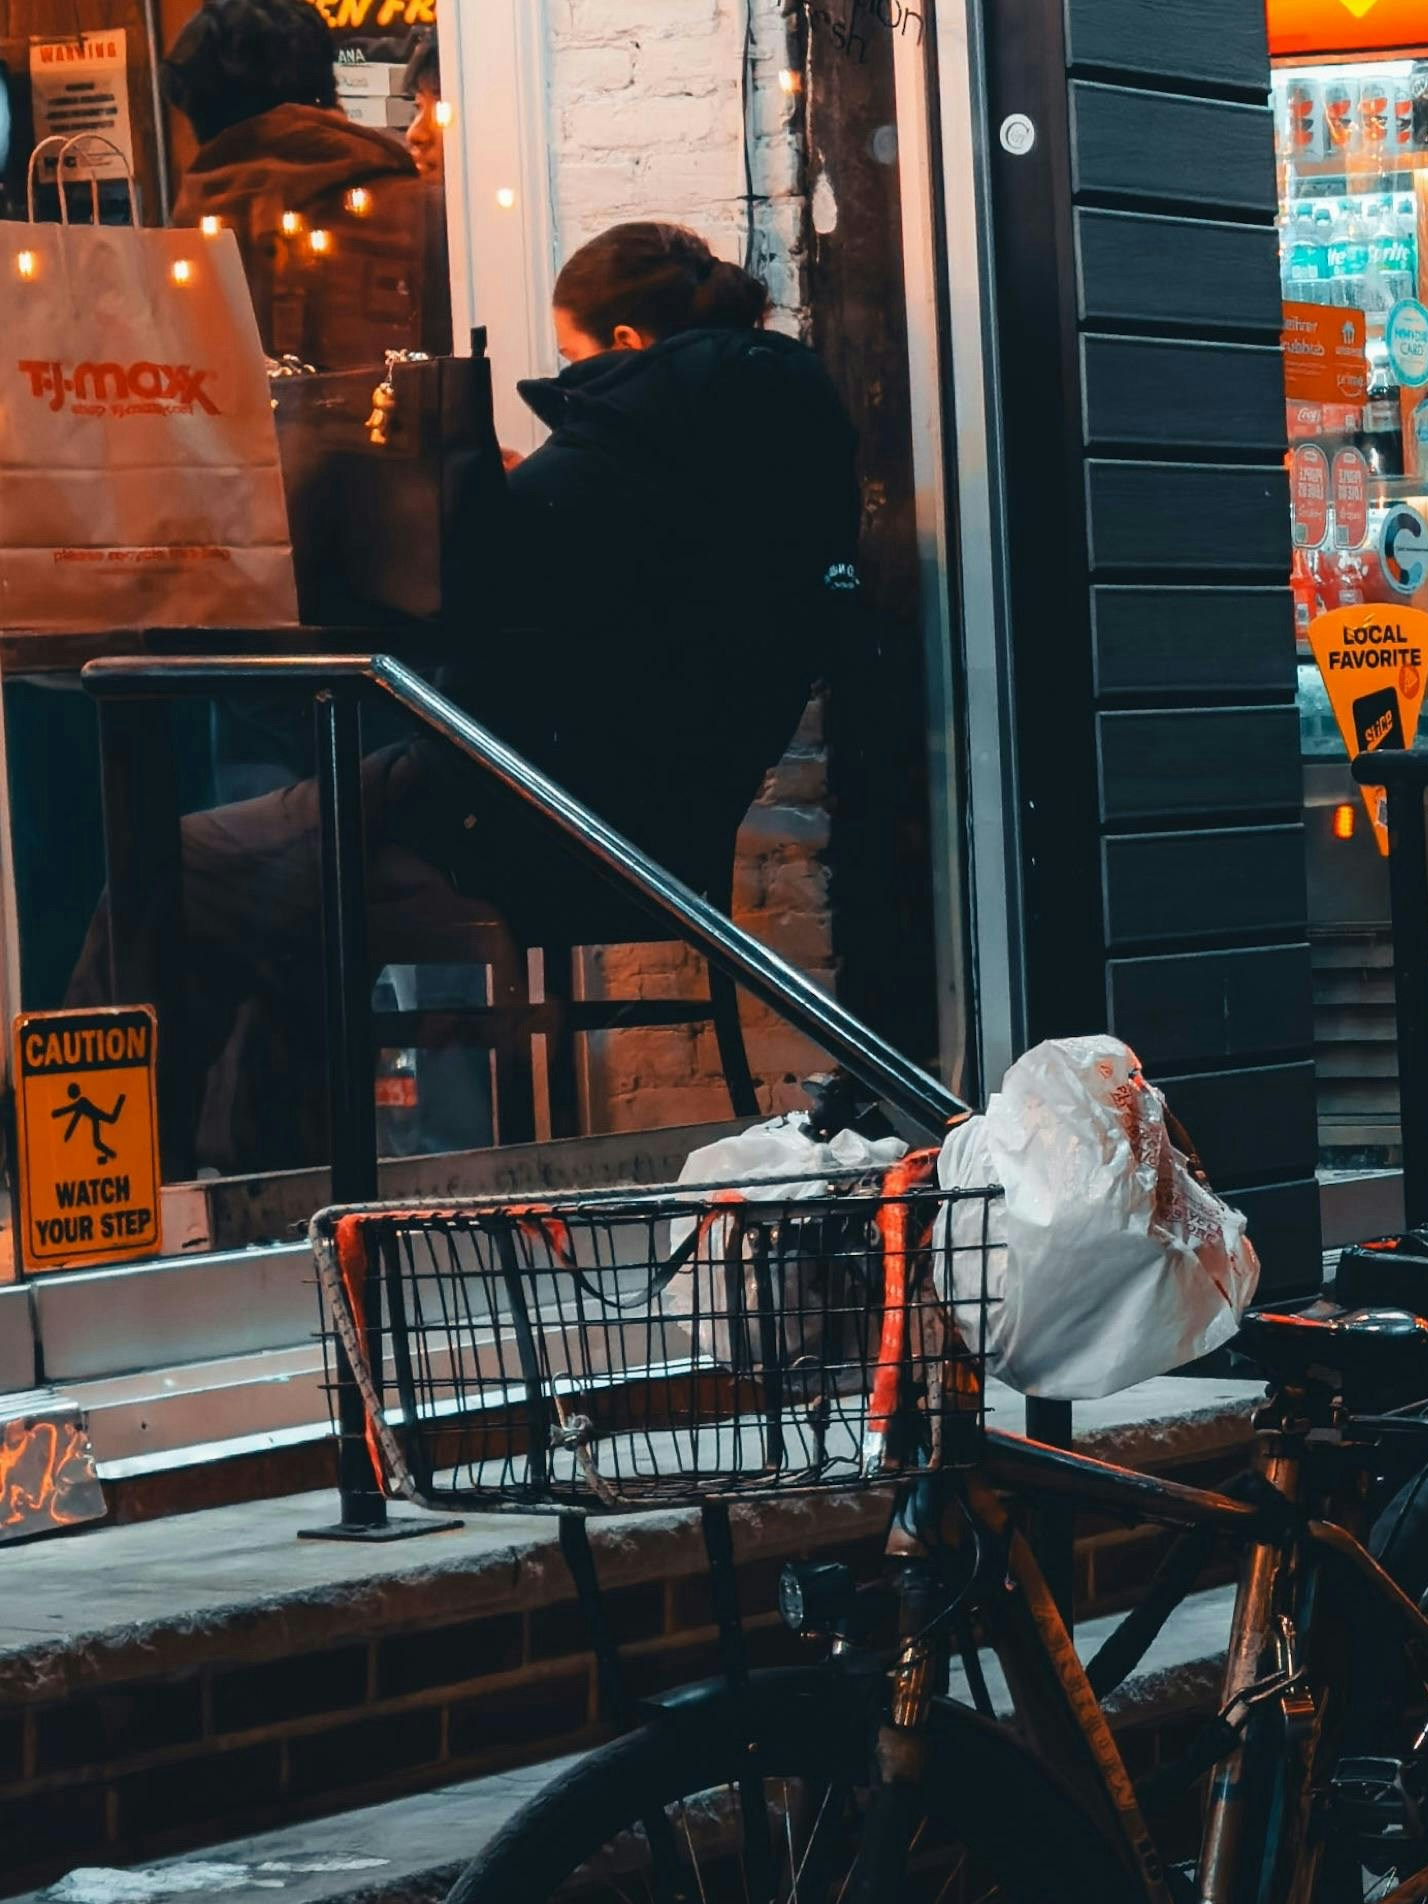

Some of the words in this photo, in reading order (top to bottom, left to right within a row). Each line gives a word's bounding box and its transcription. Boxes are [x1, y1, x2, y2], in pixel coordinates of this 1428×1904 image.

[1343, 624, 1408, 646] LOCAL
[1328, 648, 1422, 670] FAVORITE
[25, 1025, 148, 1068] CAUTION
[55, 1174, 131, 1210] WATCH
[34, 1212, 95, 1246] YOUR
[100, 1207, 152, 1240] STEP
